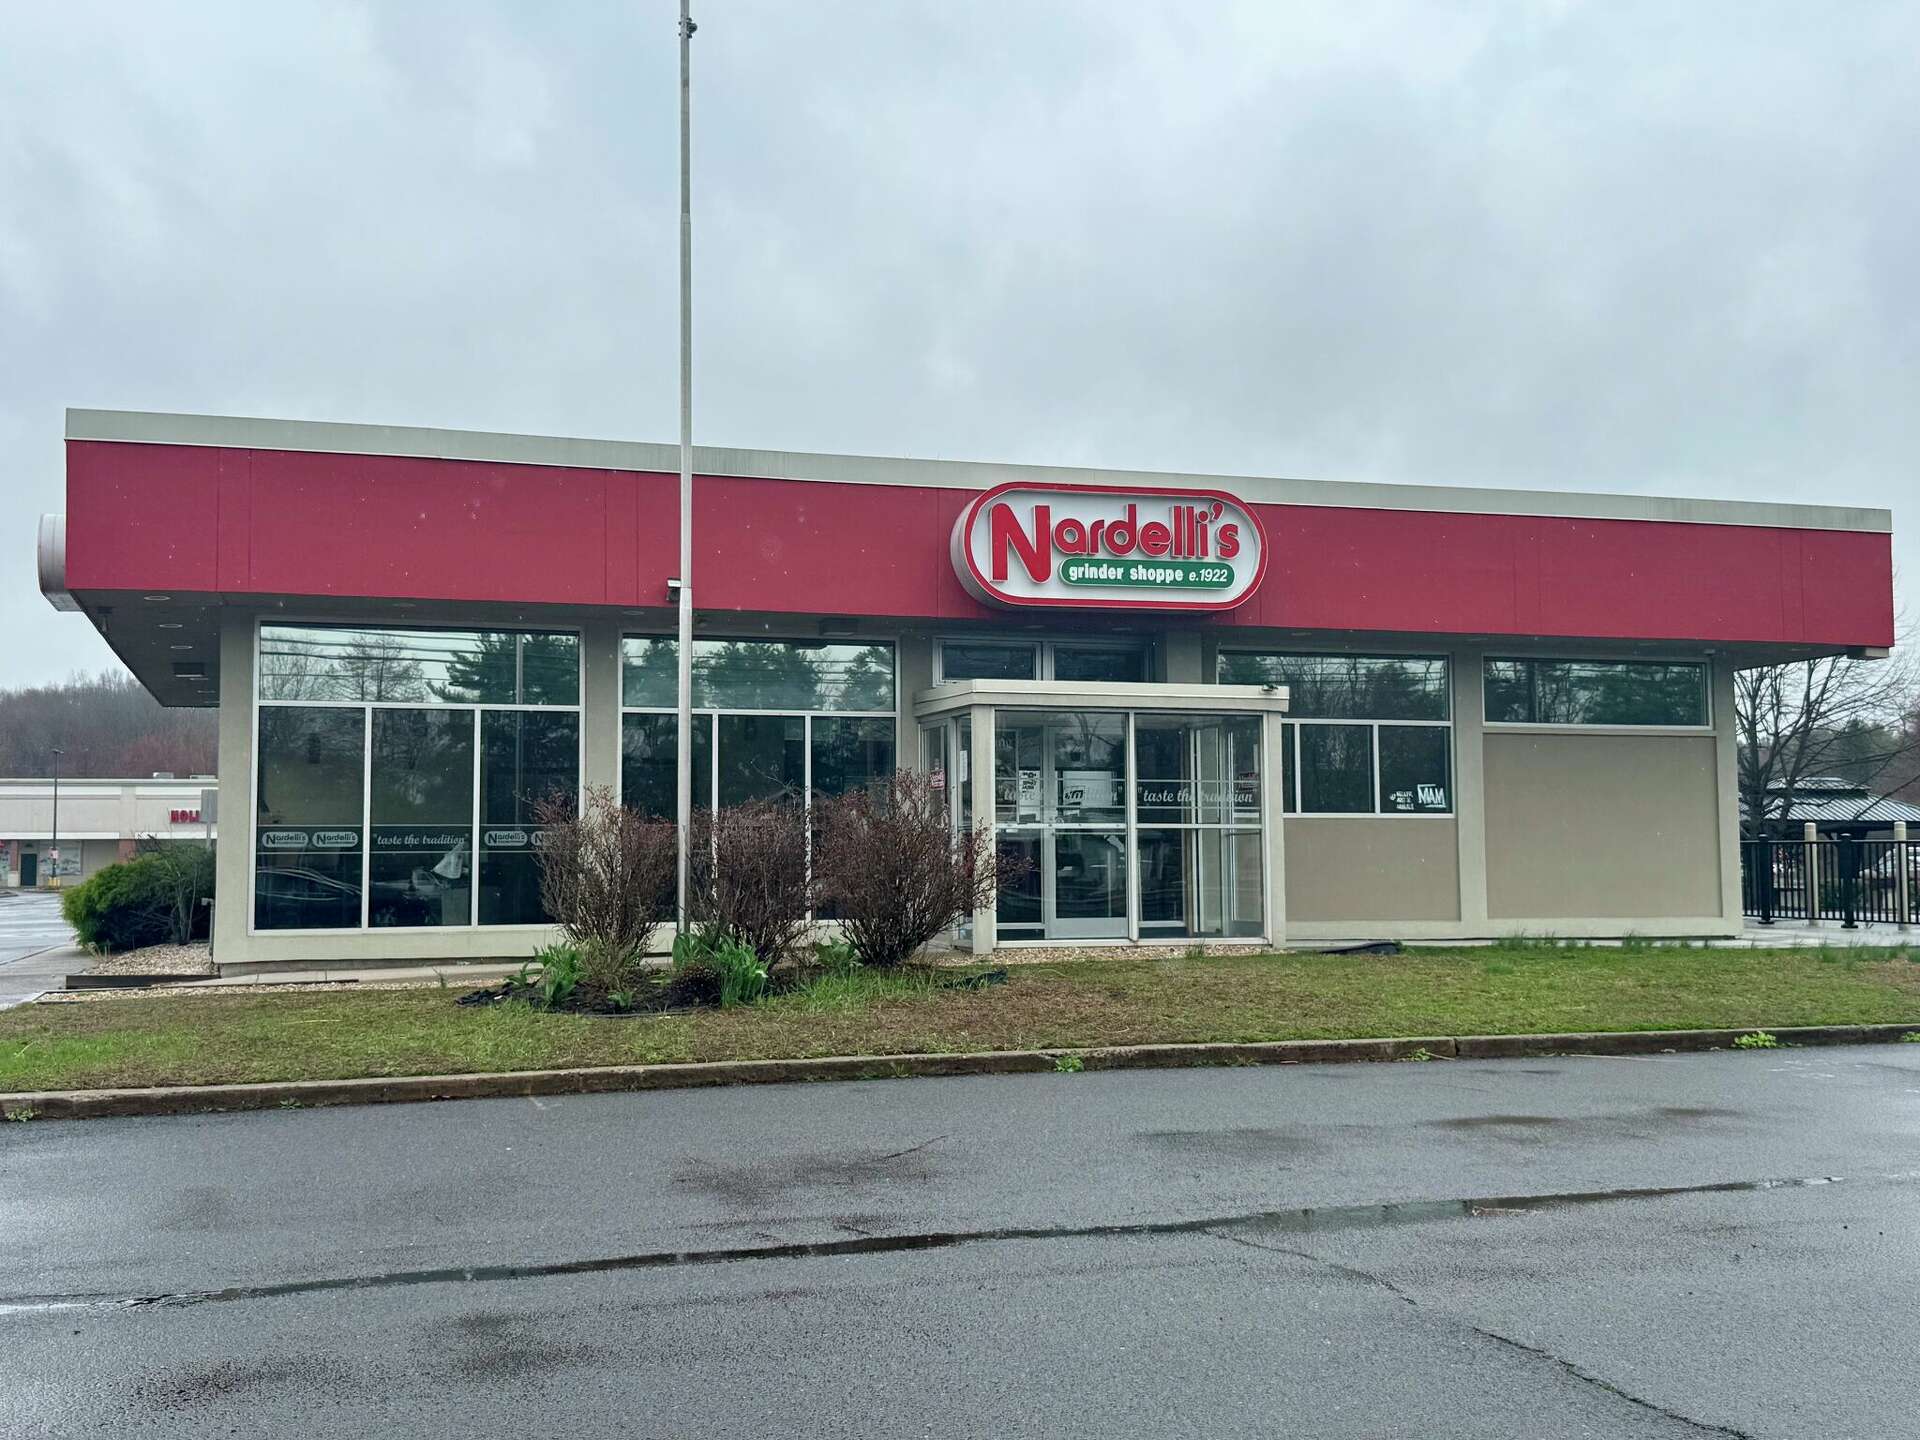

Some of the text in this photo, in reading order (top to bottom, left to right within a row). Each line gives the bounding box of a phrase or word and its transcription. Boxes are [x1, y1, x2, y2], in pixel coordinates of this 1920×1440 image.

[989, 502, 1241, 584] Nardelli's
[1069, 563, 1228, 584] grinder shoppe e.1922
